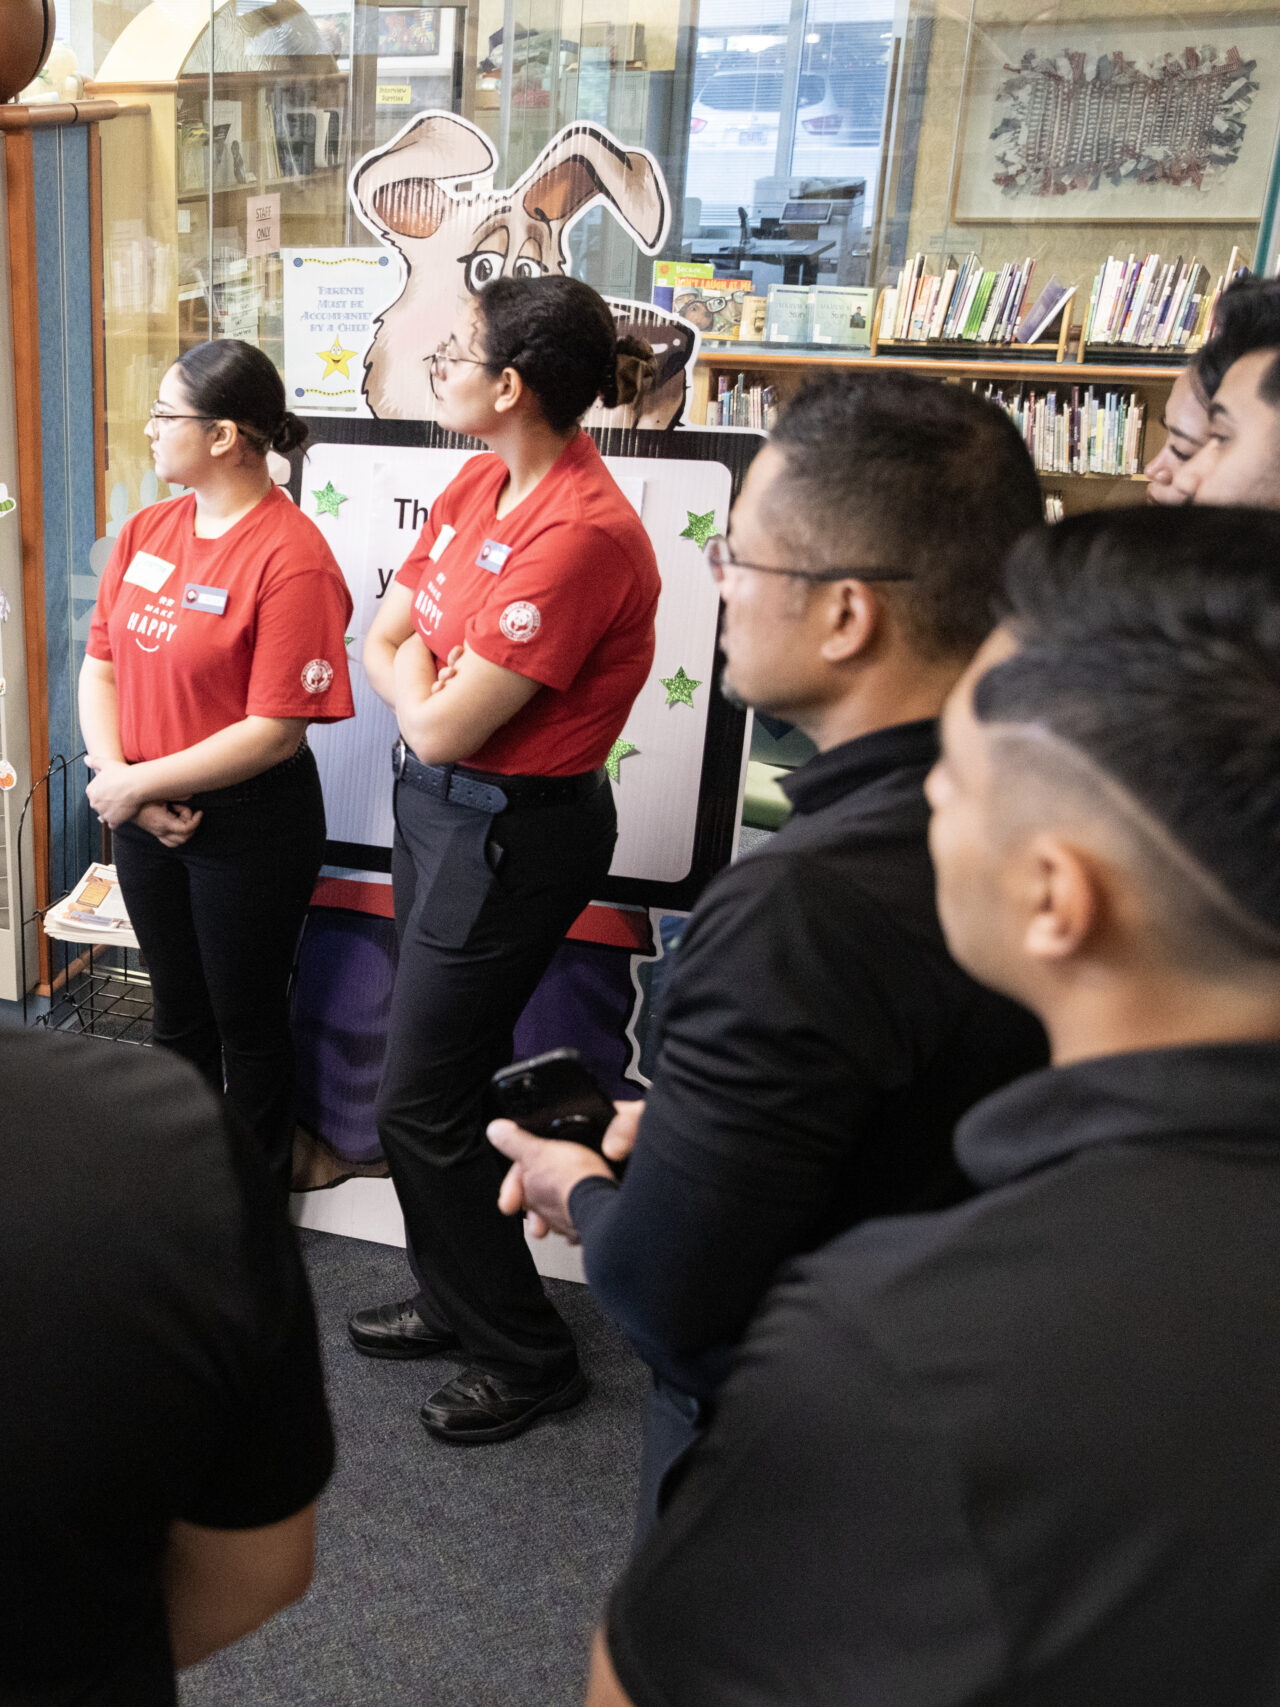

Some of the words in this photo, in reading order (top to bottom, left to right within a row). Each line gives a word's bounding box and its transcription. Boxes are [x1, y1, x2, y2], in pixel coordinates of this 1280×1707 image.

[255, 205, 272, 219] STAFF
[256, 225, 271, 239] ONLY
[701, 278, 727, 290] LAUGH
[728, 280, 738, 290] AT
[144, 603, 175, 619] MAKE
[414, 590, 444, 631] HAPPY
[126, 611, 178, 642] HAPPY
